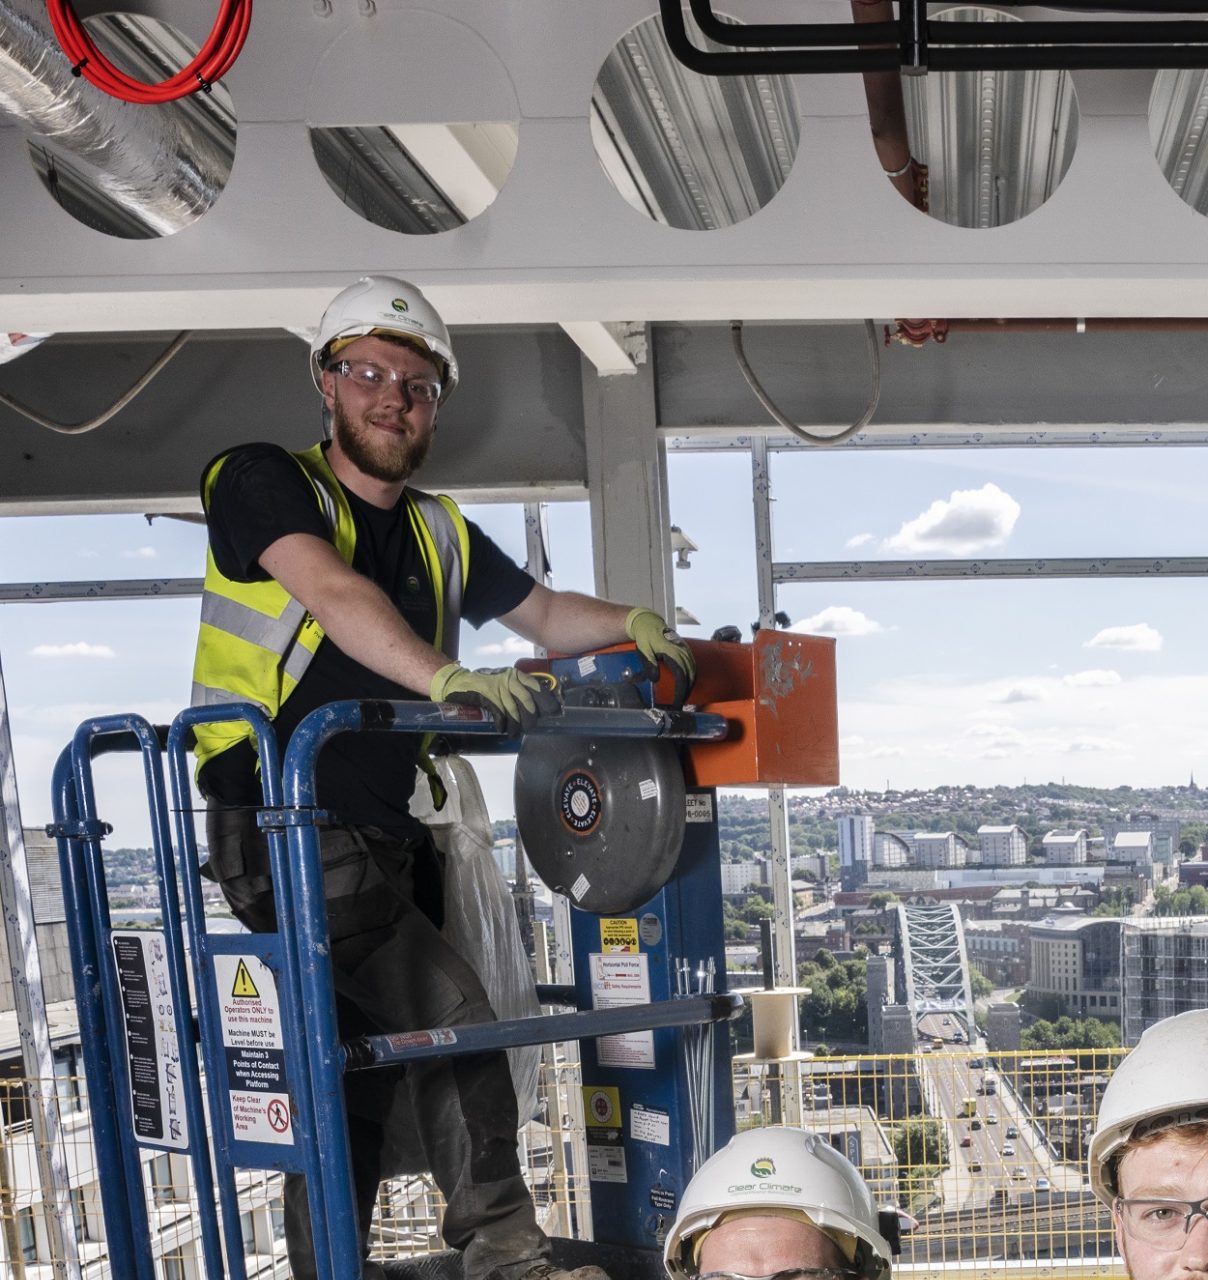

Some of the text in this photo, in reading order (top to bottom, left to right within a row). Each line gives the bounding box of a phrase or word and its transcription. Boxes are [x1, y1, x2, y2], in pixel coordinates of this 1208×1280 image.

[576, 778, 598, 804] ELEVATE
[561, 782, 574, 820] ELEVATE
[573, 811, 597, 828] ELEVATE
[224, 1006, 250, 1014] Operators
[228, 1029, 250, 1037] Machine
[251, 1030, 268, 1038] MUST
[231, 1038, 245, 1046] Level
[247, 1039, 264, 1047] before
[241, 1051, 264, 1059] Maintain
[233, 1060, 251, 1068] Points
[257, 1062, 280, 1070] Contact
[251, 1071, 279, 1081] Accessing
[245, 1080, 269, 1088] Platform
[232, 1095, 261, 1104] Keep Clear
[239, 1106, 266, 1114] Machine's
[234, 1114, 257, 1124] Working
[727, 1183, 757, 1194] Clear
[759, 1182, 803, 1194] Climate
